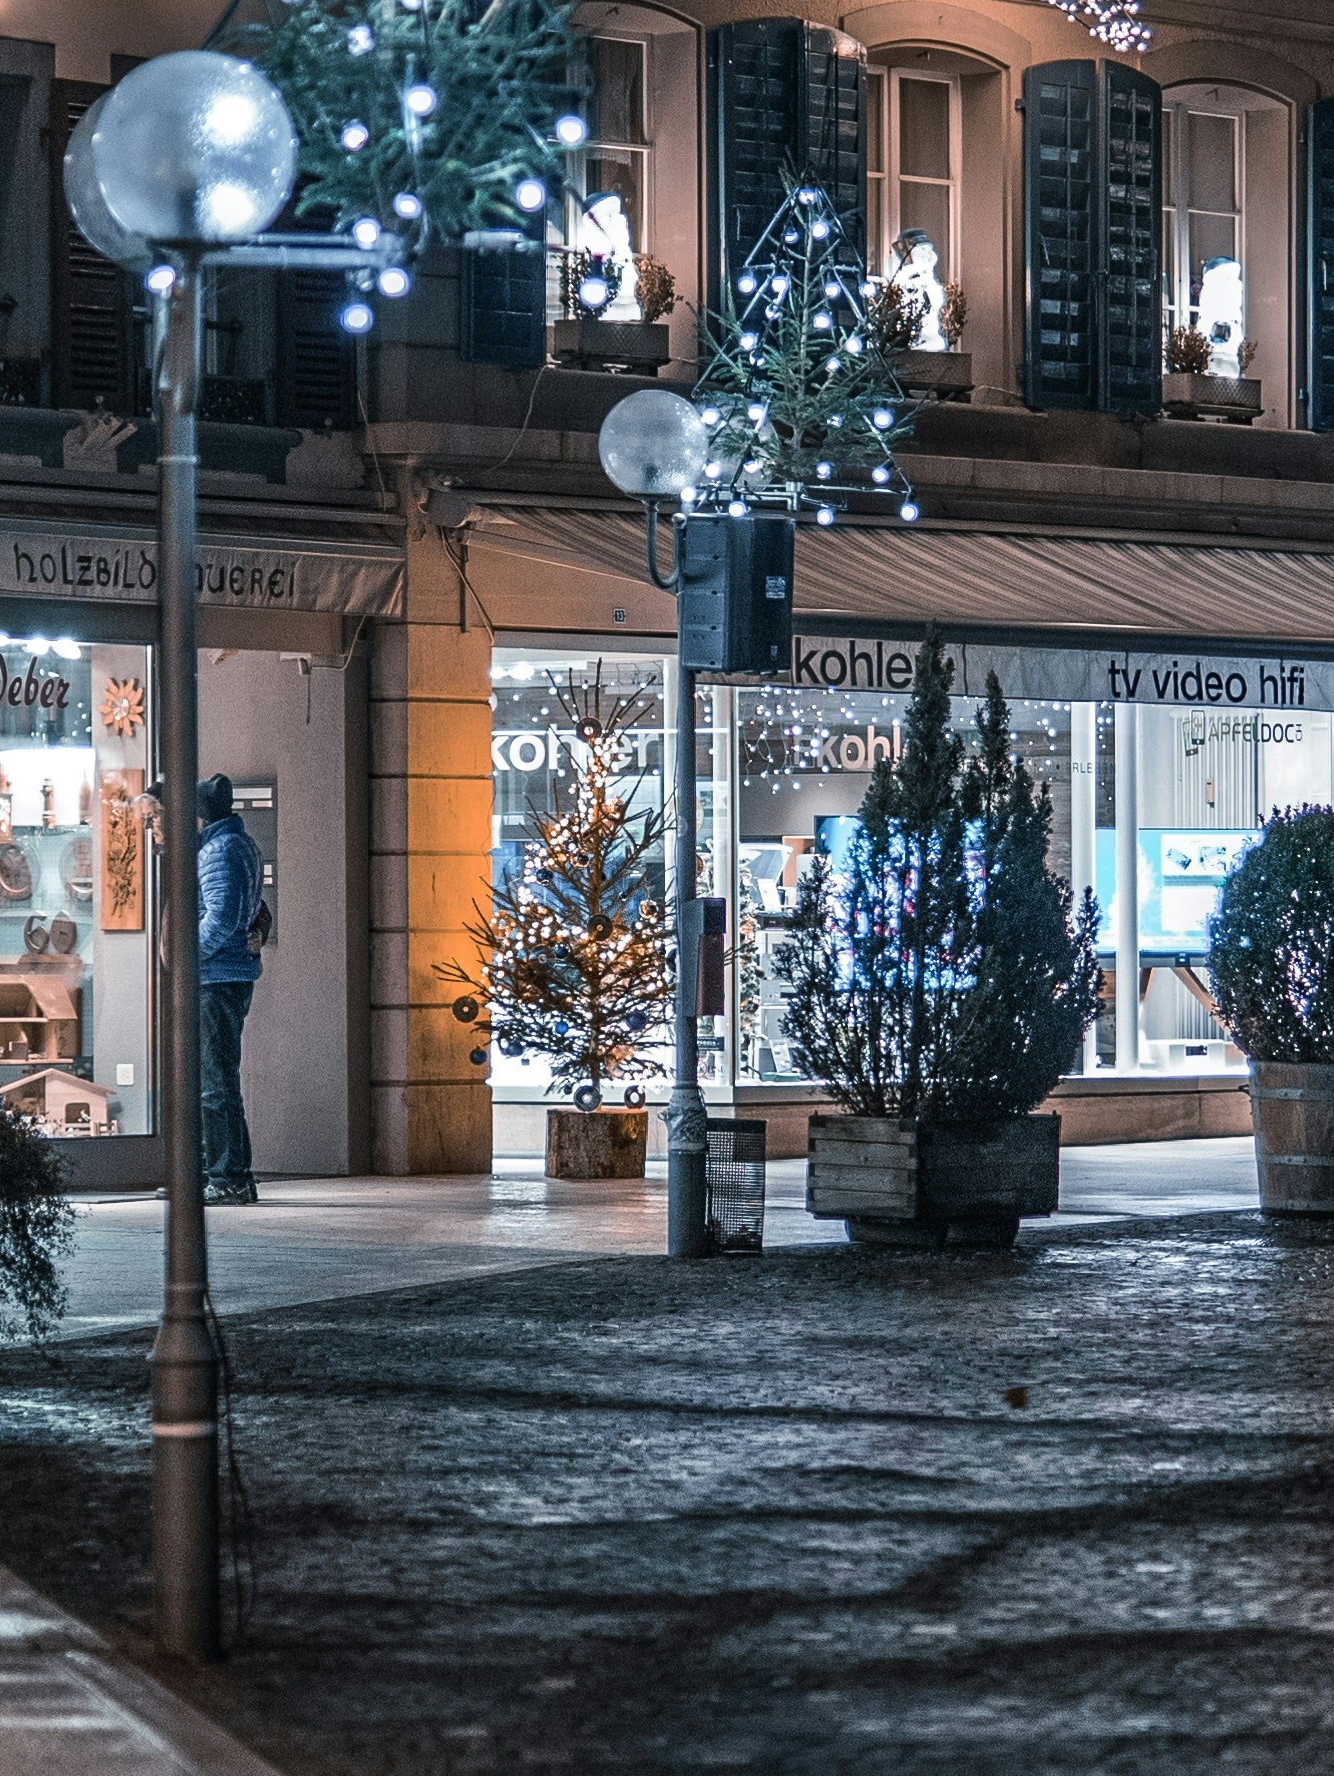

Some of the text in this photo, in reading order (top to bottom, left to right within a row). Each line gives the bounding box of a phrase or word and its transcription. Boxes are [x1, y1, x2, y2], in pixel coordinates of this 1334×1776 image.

[794, 636, 921, 690] kohle
[1108, 659, 1305, 705] tv video hifi
[491, 723, 660, 772] koher
[816, 723, 907, 770] kohl
